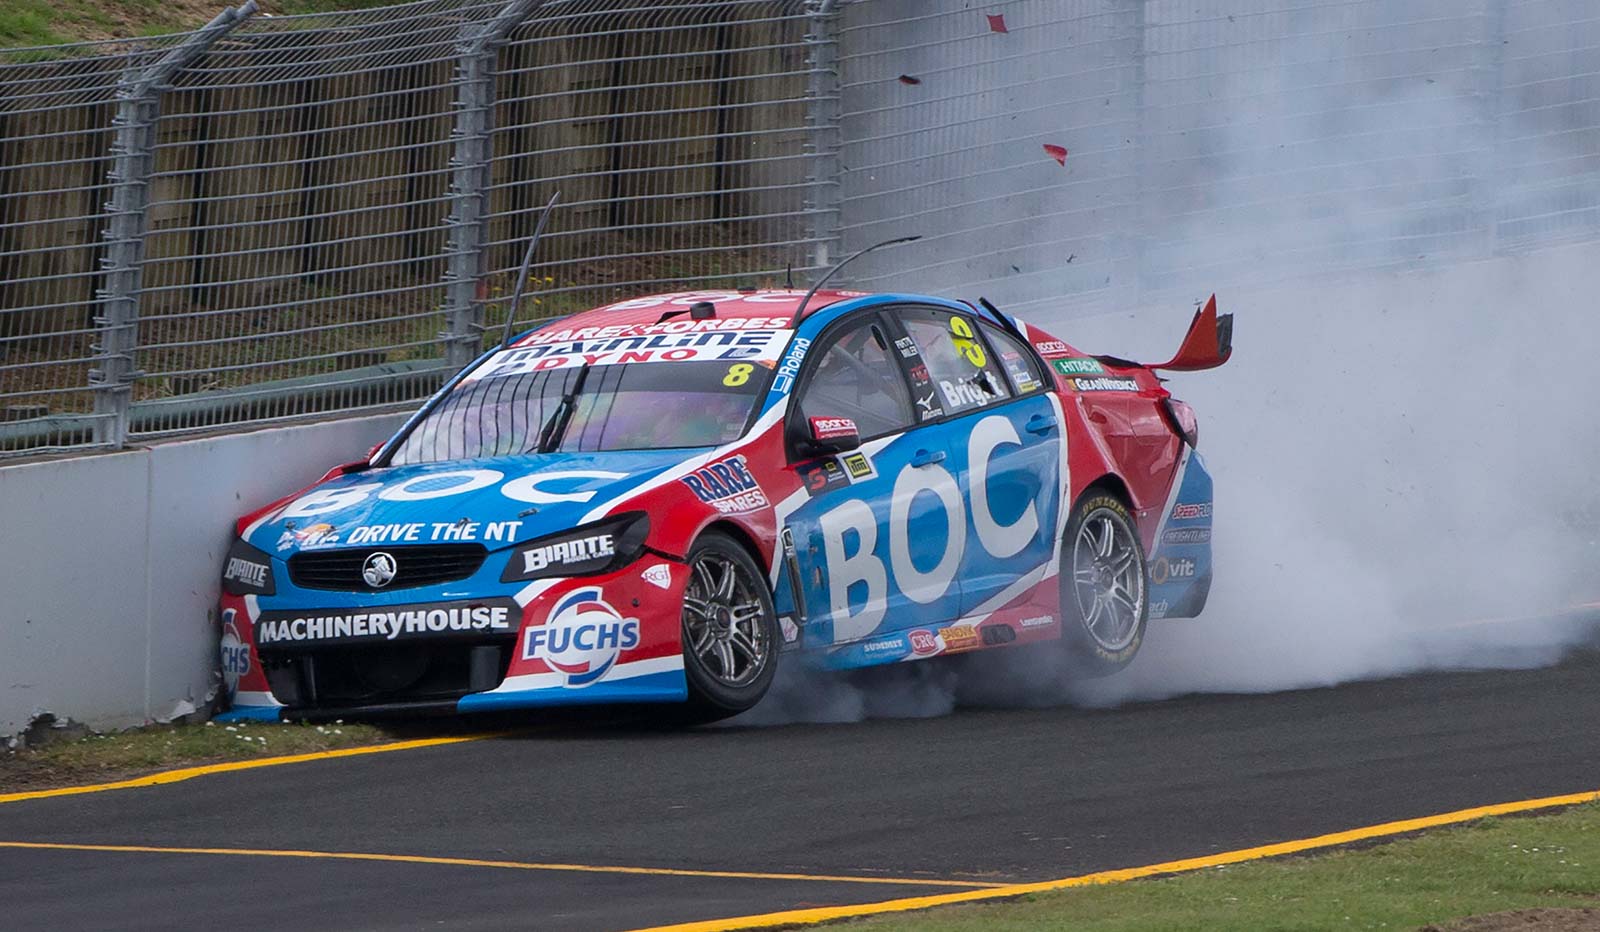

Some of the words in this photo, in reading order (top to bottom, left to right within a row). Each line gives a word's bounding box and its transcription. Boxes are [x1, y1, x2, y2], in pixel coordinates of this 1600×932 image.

[533, 349, 700, 371] DYNO
[778, 337, 811, 378] Roland
[1060, 360, 1103, 373] HITACHI
[722, 363, 754, 387] 8
[940, 371, 1004, 407] Brigt
[275, 469, 631, 517] BOC
[680, 456, 758, 502] RARE
[713, 491, 766, 514] SPARES
[347, 523, 425, 544] DRIVE
[431, 522, 480, 541] THE
[485, 521, 523, 543] NT
[820, 415, 1039, 645] BOC
[523, 535, 613, 573] BIANTE
[224, 558, 270, 583] BIANTE
[527, 621, 638, 657] FUCHS
[911, 633, 935, 649] CRC
[222, 646, 250, 674] CHS
